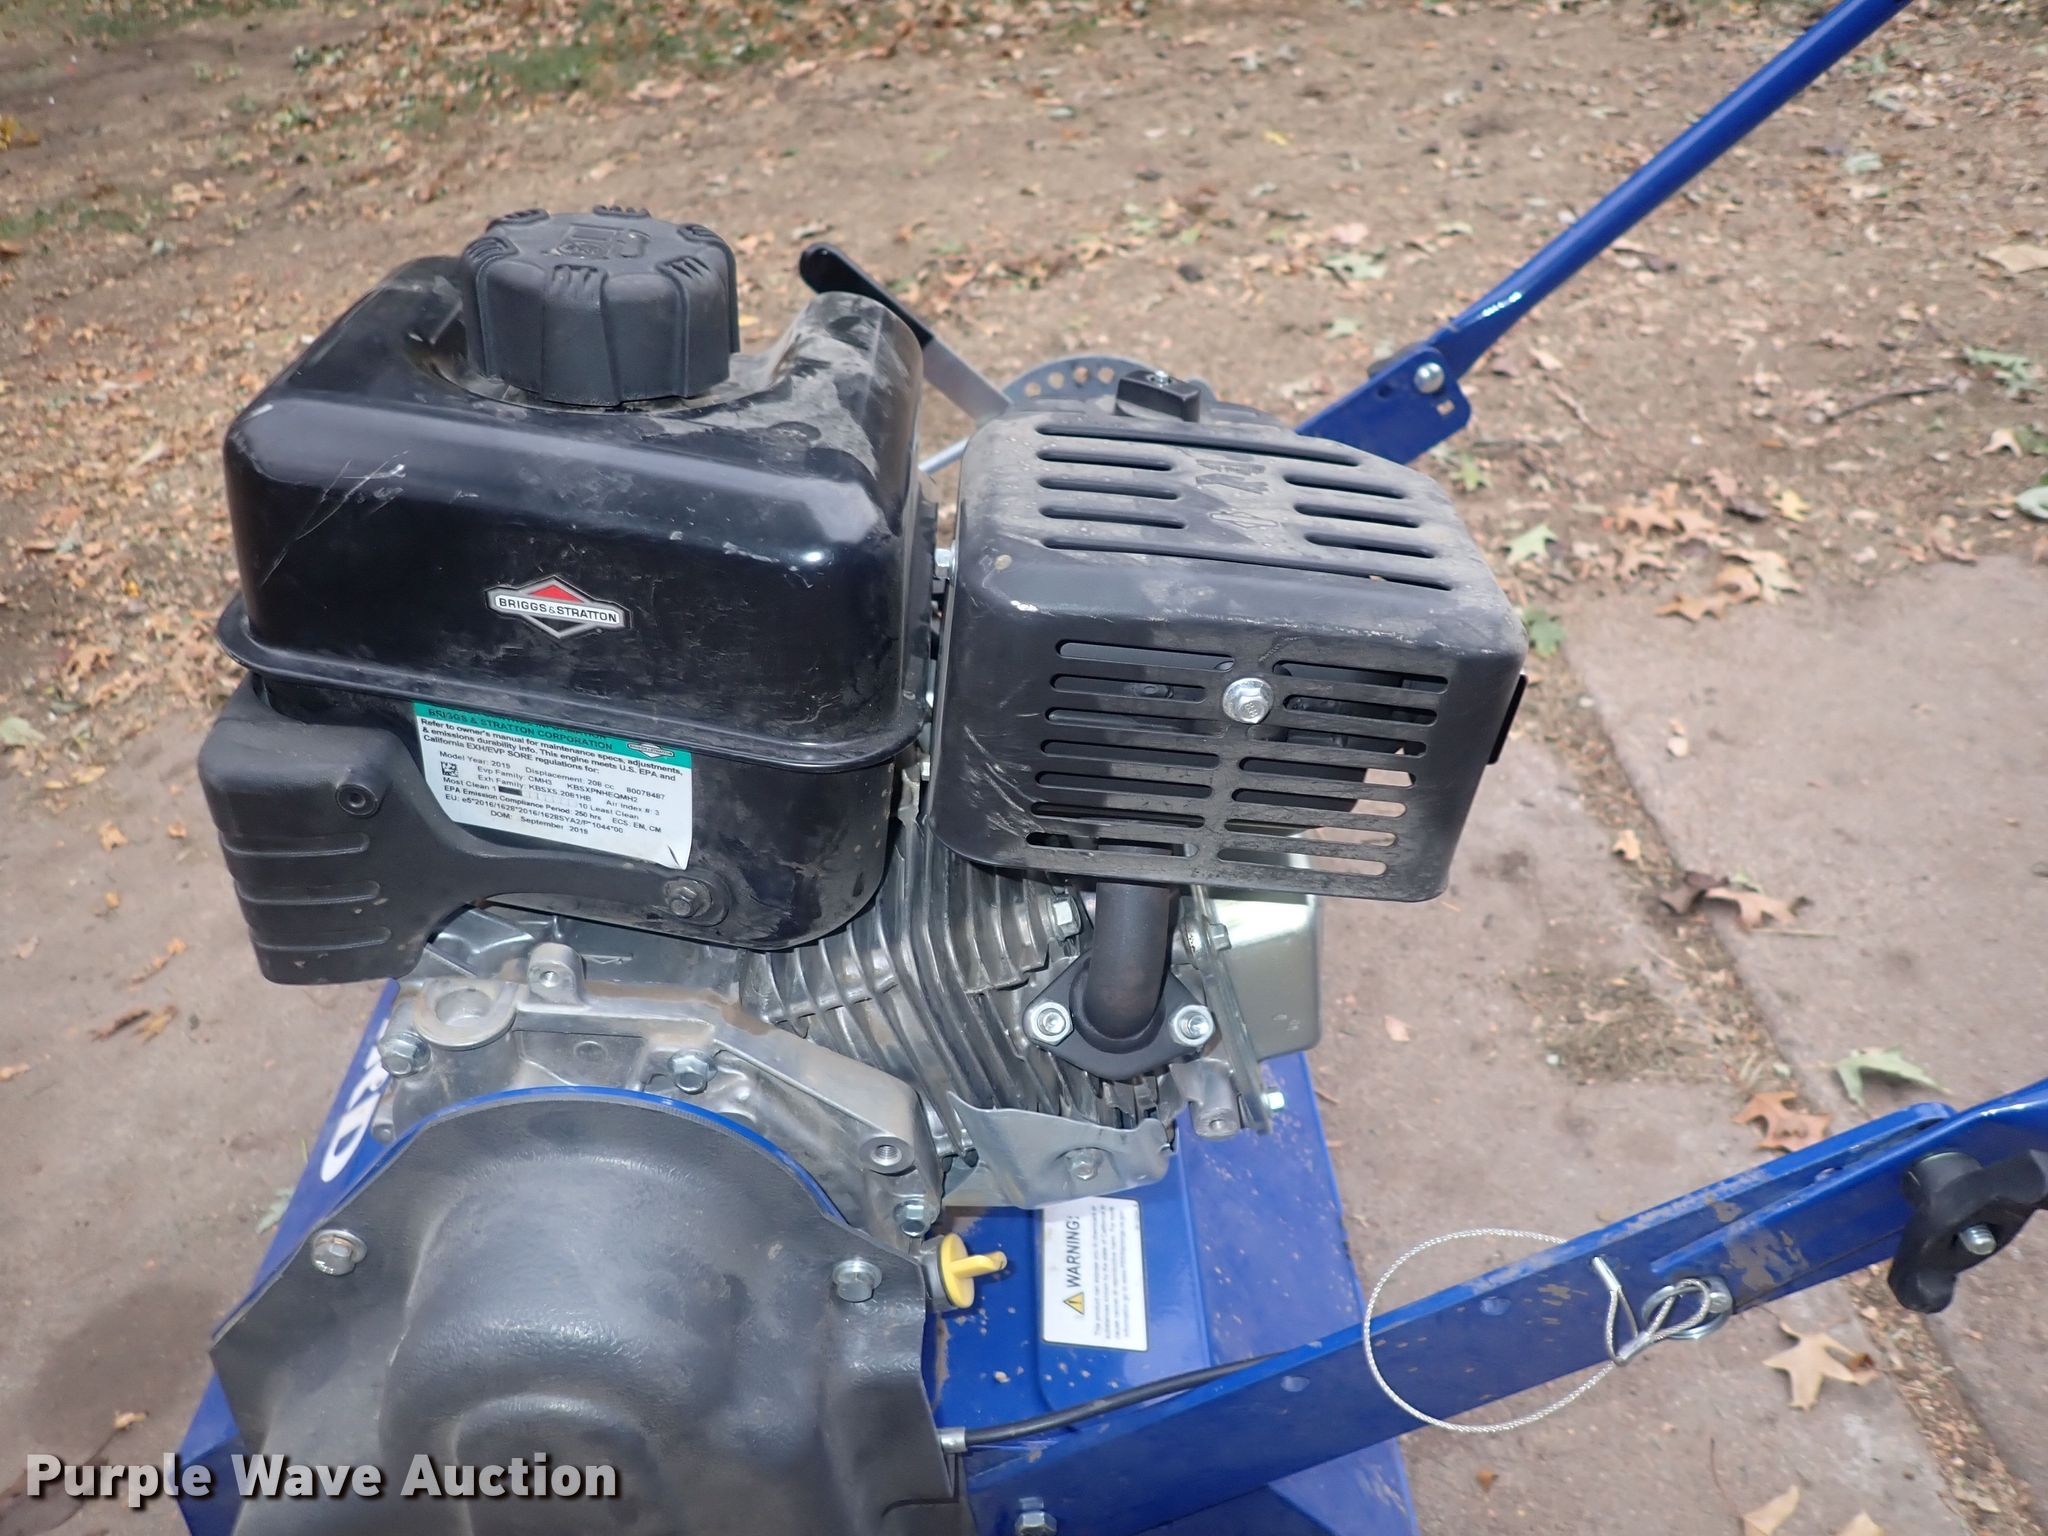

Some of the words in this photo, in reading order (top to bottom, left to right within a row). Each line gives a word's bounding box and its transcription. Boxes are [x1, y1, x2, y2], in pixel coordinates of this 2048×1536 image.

[421, 718, 444, 729] Refer
[457, 726, 491, 738] owner's
[492, 732, 525, 744] manual
[540, 741, 595, 757] maintenance
[598, 753, 625, 765] specs,
[628, 759, 683, 776] adjustments,
[423, 734, 464, 748] California
[467, 742, 505, 755] EXH/EVP
[507, 750, 533, 761] SORE
[535, 756, 583, 771] regulations
[481, 718, 534, 735] STRATTON
[538, 729, 612, 750] CORPORATION
[431, 729, 475, 742] emissions
[477, 737, 517, 751] durability
[519, 744, 537, 754] info.
[540, 748, 558, 758] This
[560, 753, 589, 765] engine
[591, 760, 617, 770] meets
[619, 764, 636, 773] U.S.
[639, 768, 657, 778] EPA
[660, 772, 676, 782] and
[440, 750, 465, 761] Model
[477, 766, 493, 776] Evp
[443, 777, 464, 786] Most
[465, 781, 490, 791] Clean
[578, 802, 588, 810] 10
[590, 804, 613, 815] Least
[615, 810, 639, 820] Clean
[444, 785, 460, 793] EPA
[462, 789, 498, 801] Emission
[499, 795, 544, 809] Compliance
[589, 813, 602, 821] hrs
[649, 825, 662, 833] CM
[478, 774, 493, 783] Exh
[620, 803, 642, 813] Index
[490, 810, 512, 819] DOM:
[520, 816, 564, 830] September
